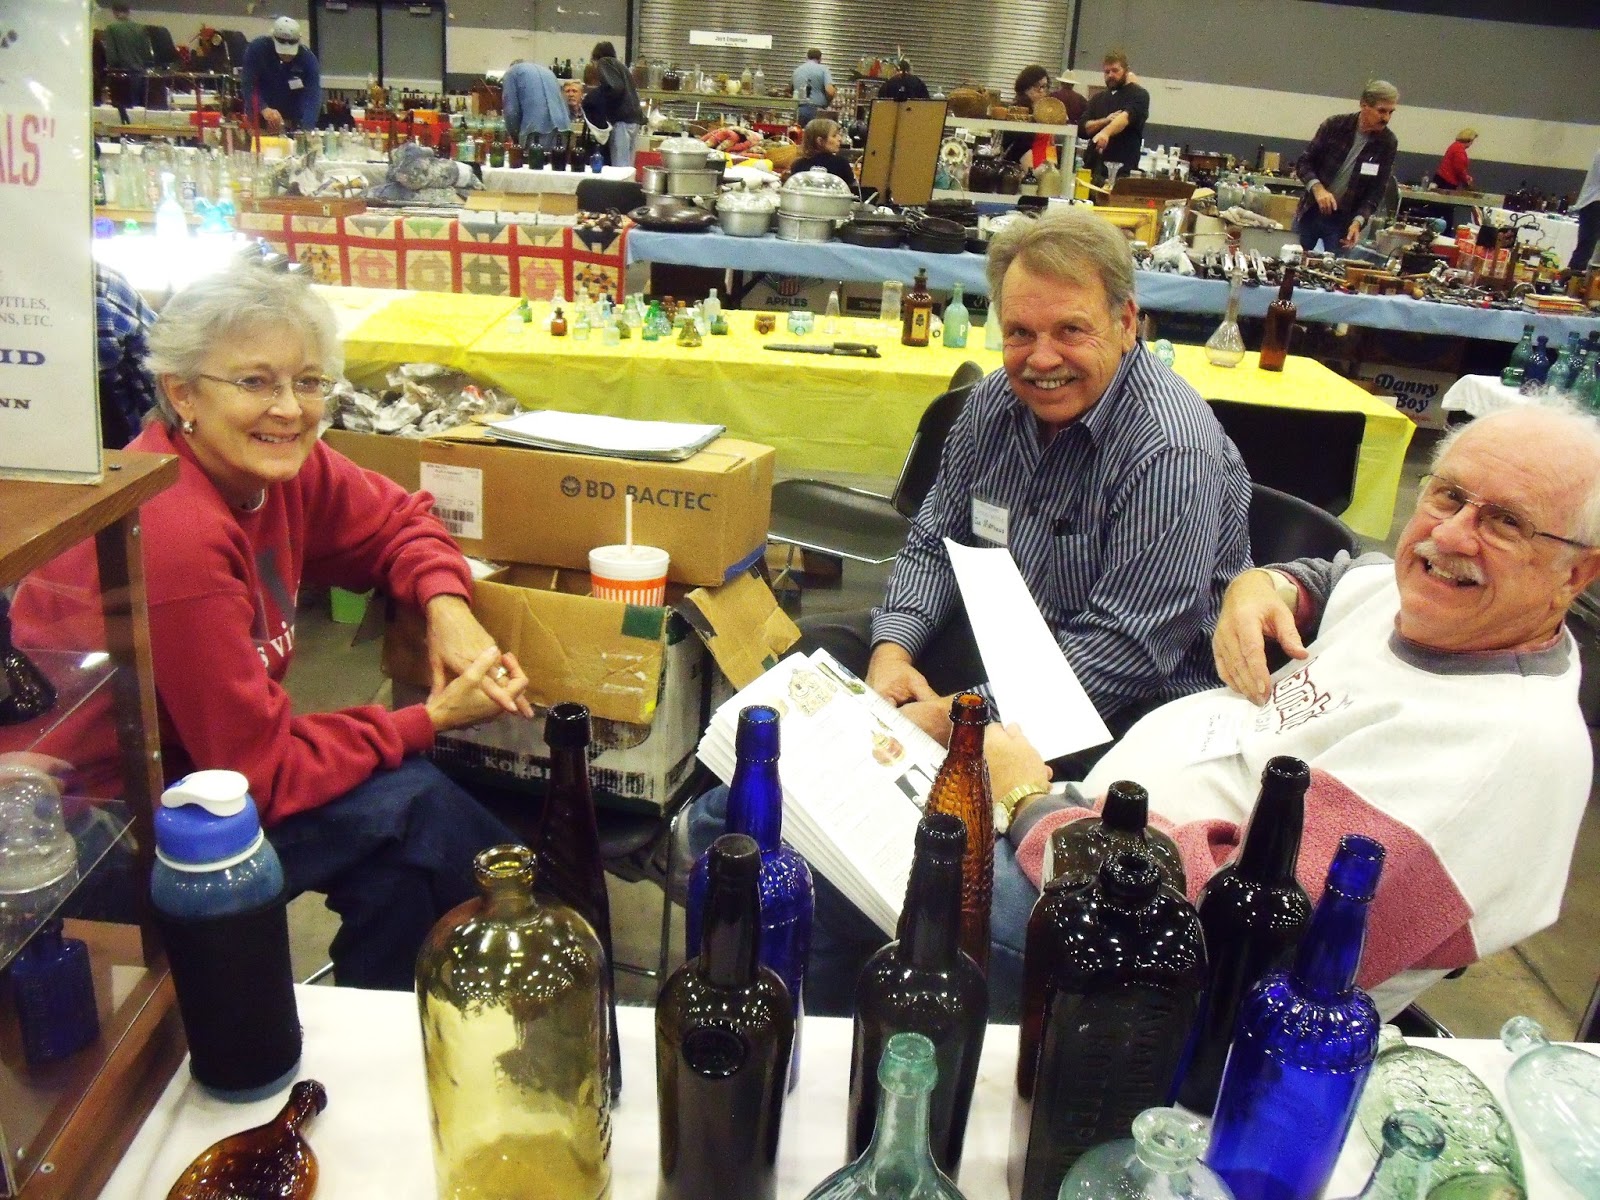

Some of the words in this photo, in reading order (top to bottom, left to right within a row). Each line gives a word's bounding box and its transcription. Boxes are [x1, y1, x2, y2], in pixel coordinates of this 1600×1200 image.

[766, 296, 808, 307] APPLES
[23, 314, 53, 327] ETC.
[1374, 373, 1439, 398] Danny
[1393, 392, 1429, 413] Boy
[585, 479, 616, 500] BD
[626, 484, 712, 511] BACTEC
